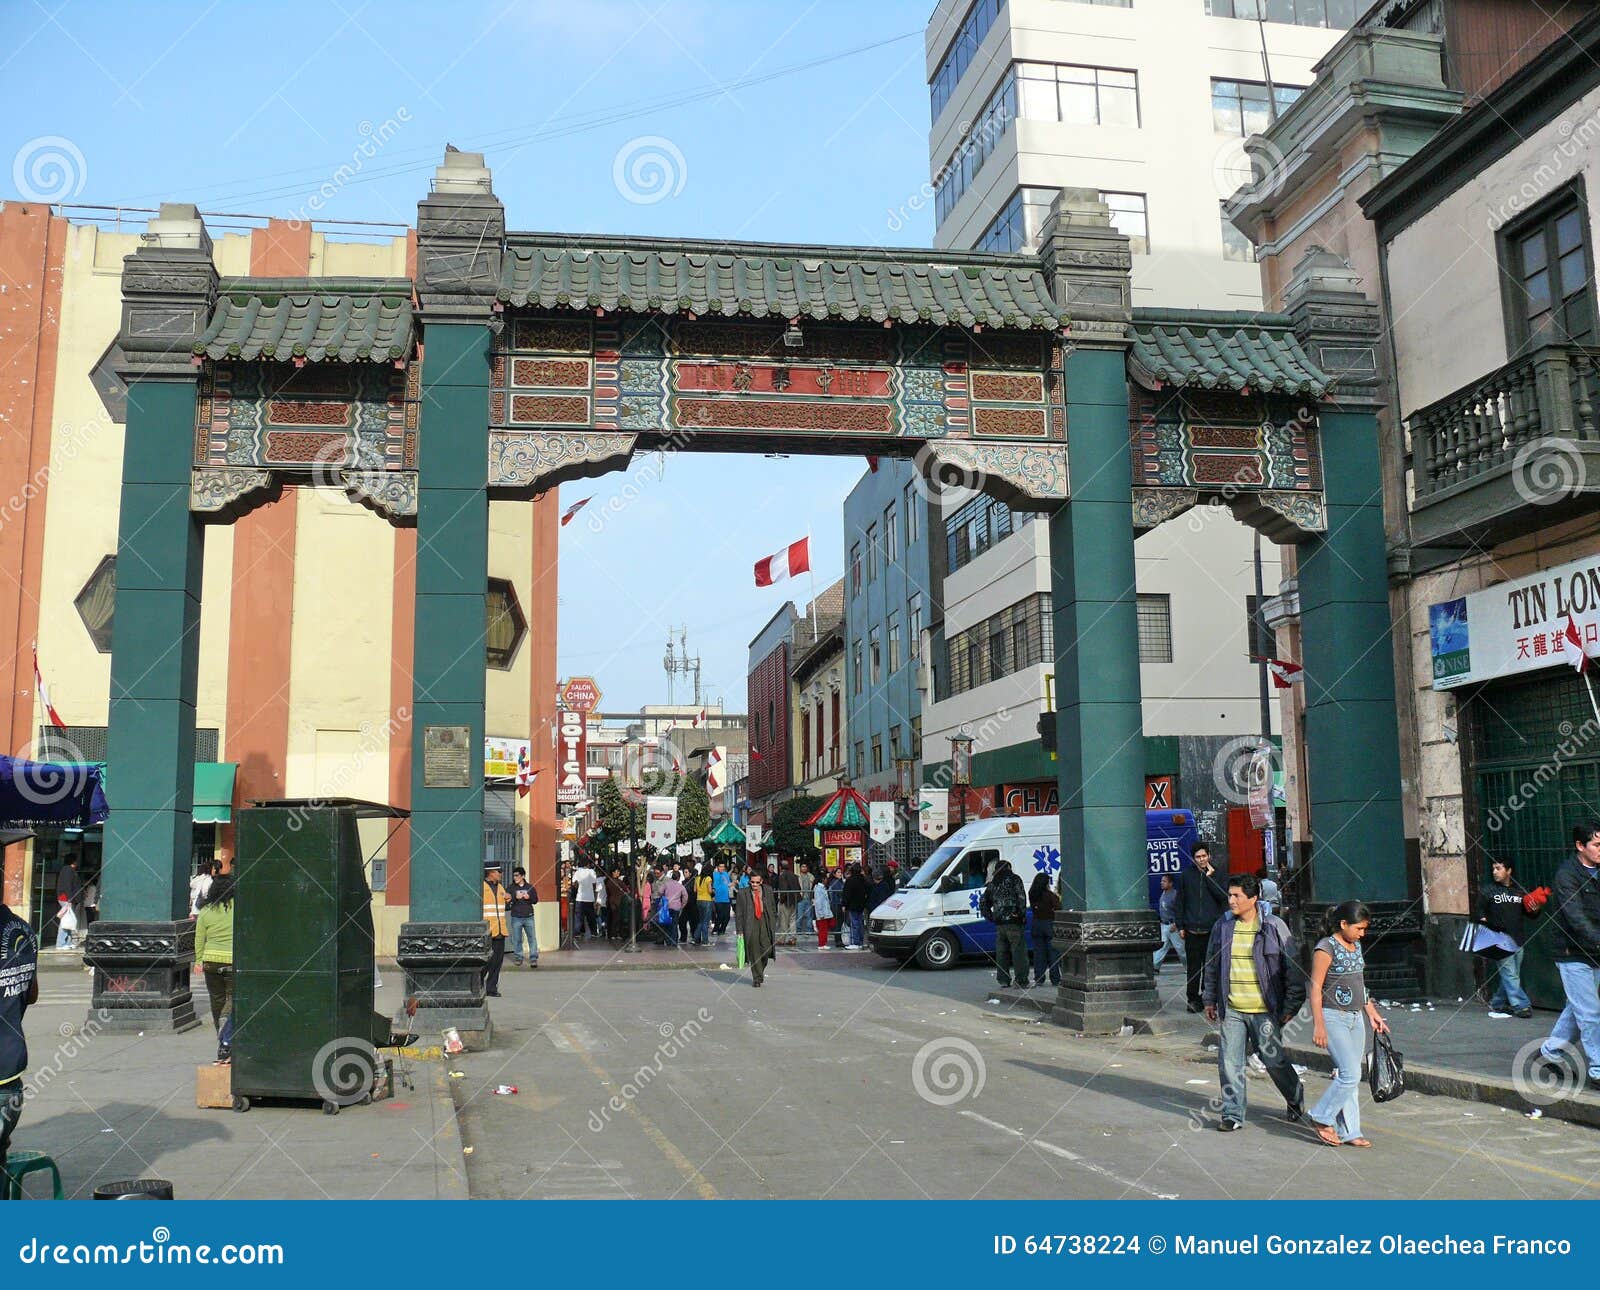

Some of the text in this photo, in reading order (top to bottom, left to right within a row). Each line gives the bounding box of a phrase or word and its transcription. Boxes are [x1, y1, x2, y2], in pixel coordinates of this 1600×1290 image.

[1508, 582, 1547, 630] TIN
[567, 692, 595, 700] CHINA
[561, 712, 584, 787] BOTICA
[828, 831, 859, 841] TAROT
[1150, 851, 1181, 872] 515
[1494, 892, 1522, 904] Silver
